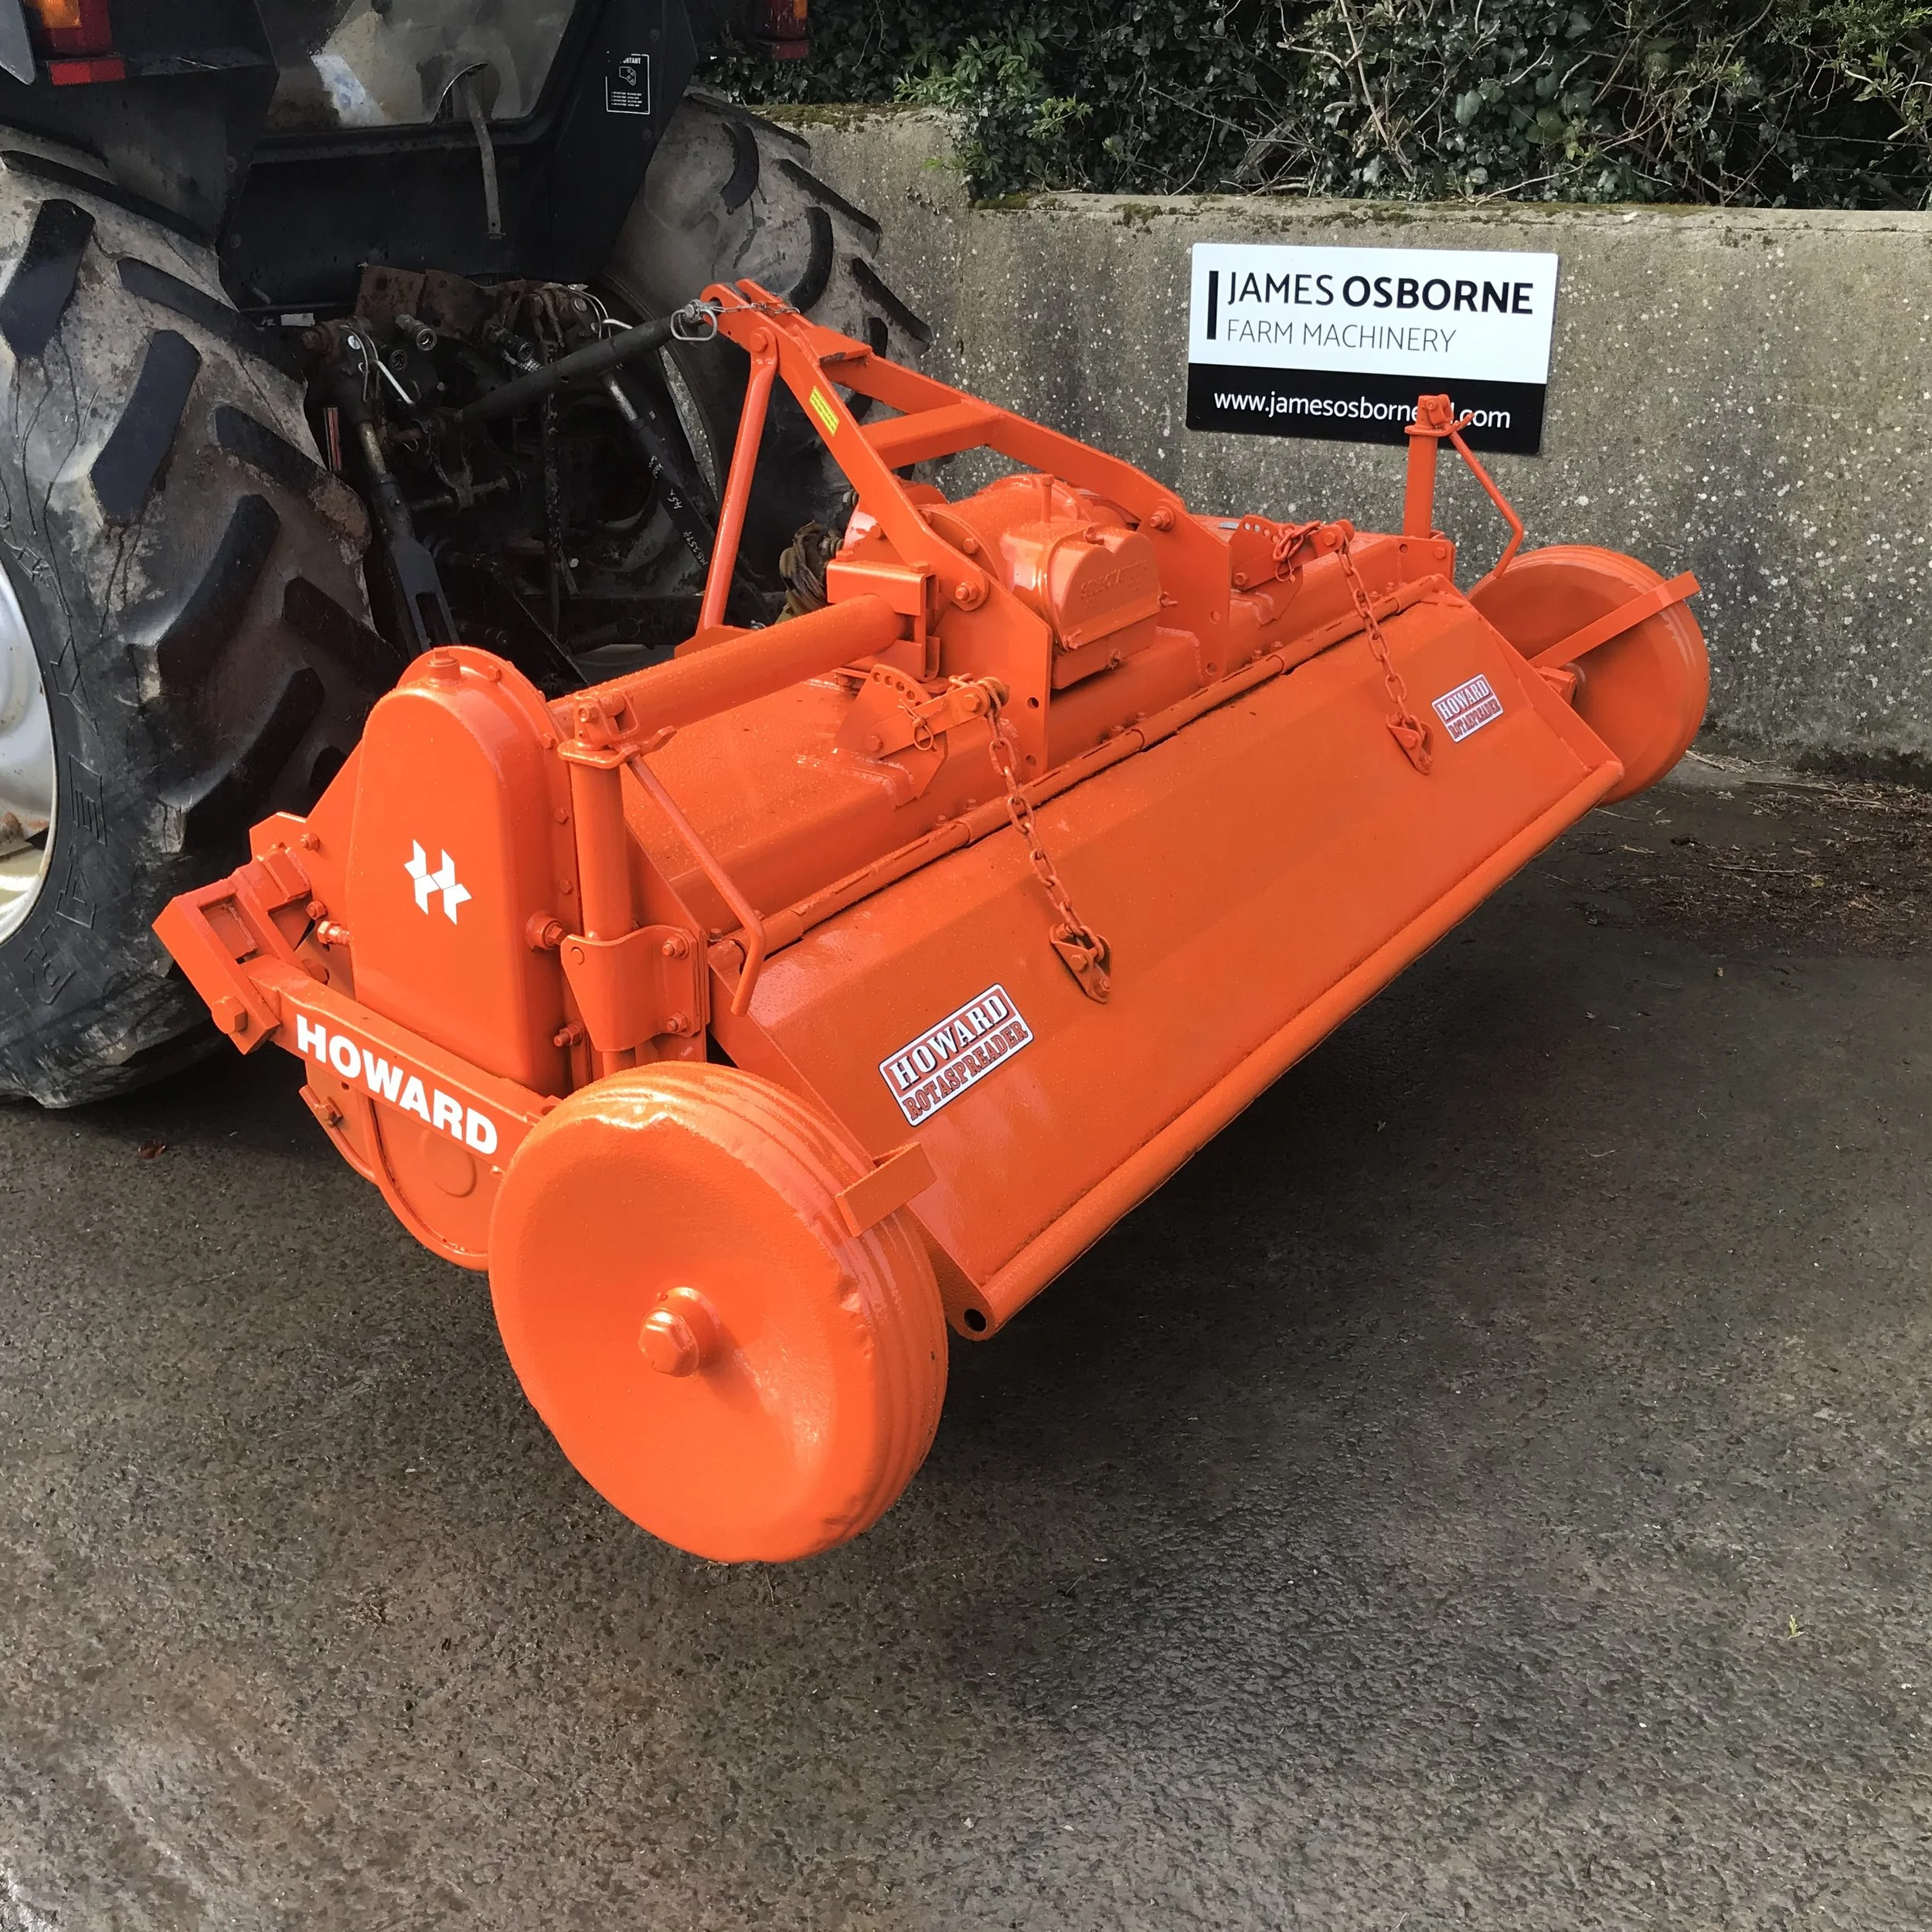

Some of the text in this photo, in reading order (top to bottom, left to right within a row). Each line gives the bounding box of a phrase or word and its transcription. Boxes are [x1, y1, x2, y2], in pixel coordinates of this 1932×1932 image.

[1227, 271, 1534, 315] JAMES OSBORNE
[1227, 319, 1457, 353] FARM MACHINERY
[1437, 680, 1490, 720] HOWARD
[889, 995, 1009, 1091] HOWARD
[902, 1020, 1029, 1121] ROTASPREADER
[297, 1014, 498, 1155] HOWARD
